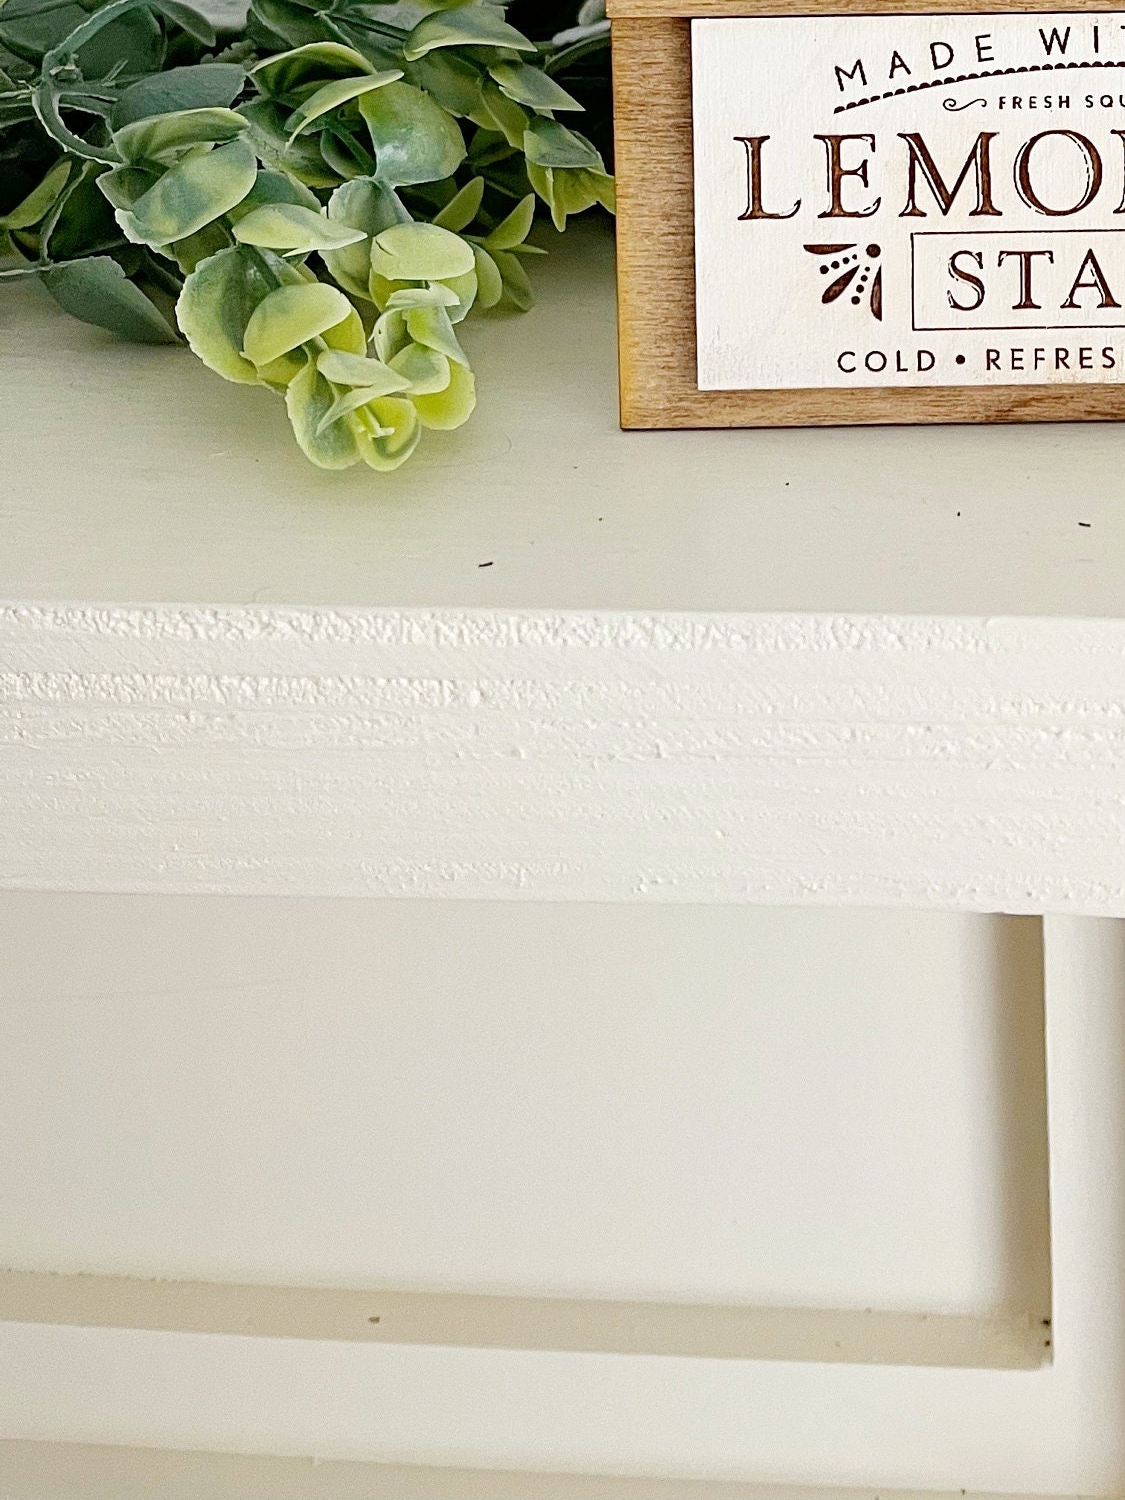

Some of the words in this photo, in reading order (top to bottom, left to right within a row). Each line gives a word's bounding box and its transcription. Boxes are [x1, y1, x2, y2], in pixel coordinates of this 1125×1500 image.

[833, 32, 996, 93] MADE
[998, 95, 1070, 110] FRESH
[836, 350, 936, 374] COLD
